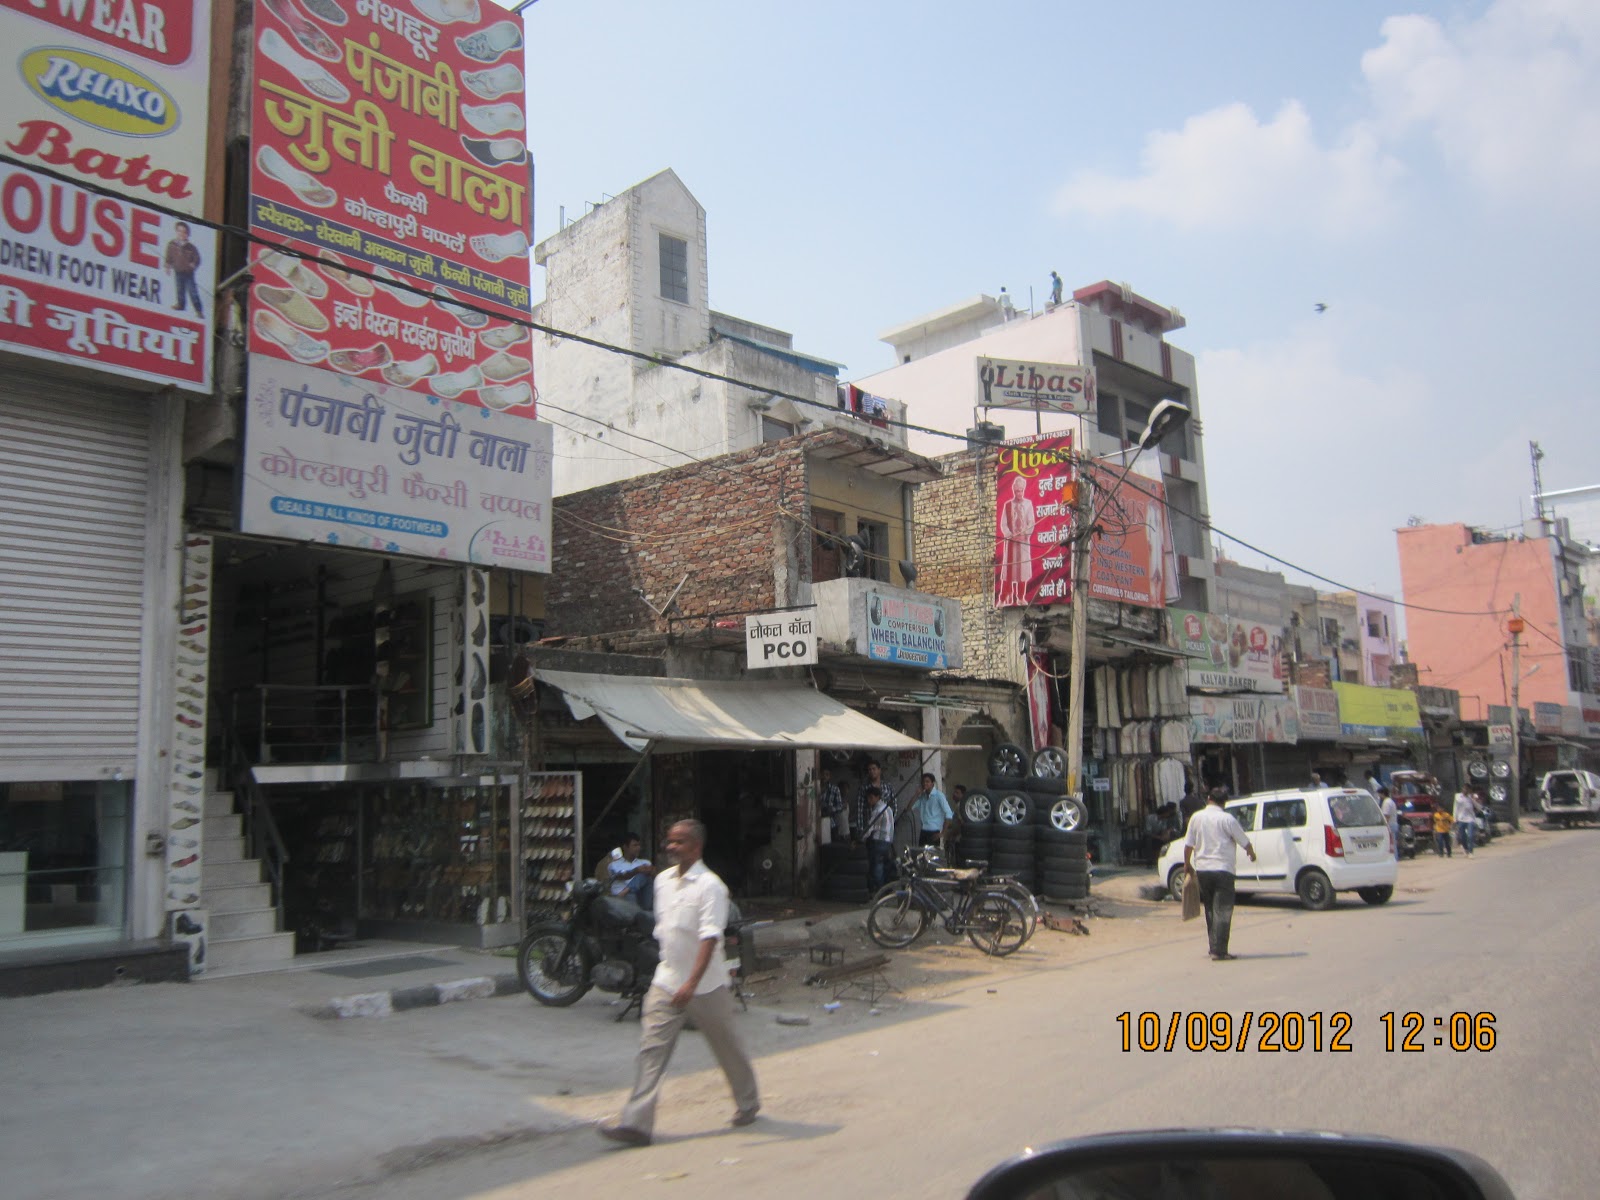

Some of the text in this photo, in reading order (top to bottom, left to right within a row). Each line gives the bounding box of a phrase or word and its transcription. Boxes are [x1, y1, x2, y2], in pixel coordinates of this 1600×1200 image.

[356, 0, 441, 62] मशहूर
[37, 54, 167, 122] RELAXO
[344, 31, 460, 131] पंजाबी
[5, 119, 192, 200] Bata
[259, 79, 525, 226] जुत्ती वाला
[384, 181, 429, 216] फैन्सी
[344, 196, 467, 255] कोल्हापुरी चप्पलें
[57, 250, 106, 285] FOOT
[112, 267, 162, 304] WEAR
[440, 260, 471, 287] फैन्सी
[472, 273, 505, 298] पंजाबी
[506, 287, 529, 307] जुत्ती
[45, 304, 199, 365] जूतियाँ
[333, 298, 362, 330] इन्डो
[994, 364, 1082, 394] Libas
[280, 384, 530, 474] पंजाबी जुत्ती वाला
[259, 446, 544, 522] कोल्हापुरी फैन्सी चप्पल
[277, 500, 443, 536] DEALS IN ALL KINDS OF FOOTWEAR
[1114, 560, 1146, 577] WESTERN
[750, 617, 812, 639] लोकल कॉल
[763, 641, 807, 660] PCO
[871, 627, 946, 653] WHEEL BALANCING
[1200, 671, 1257, 691] KALYAN BAKERY
